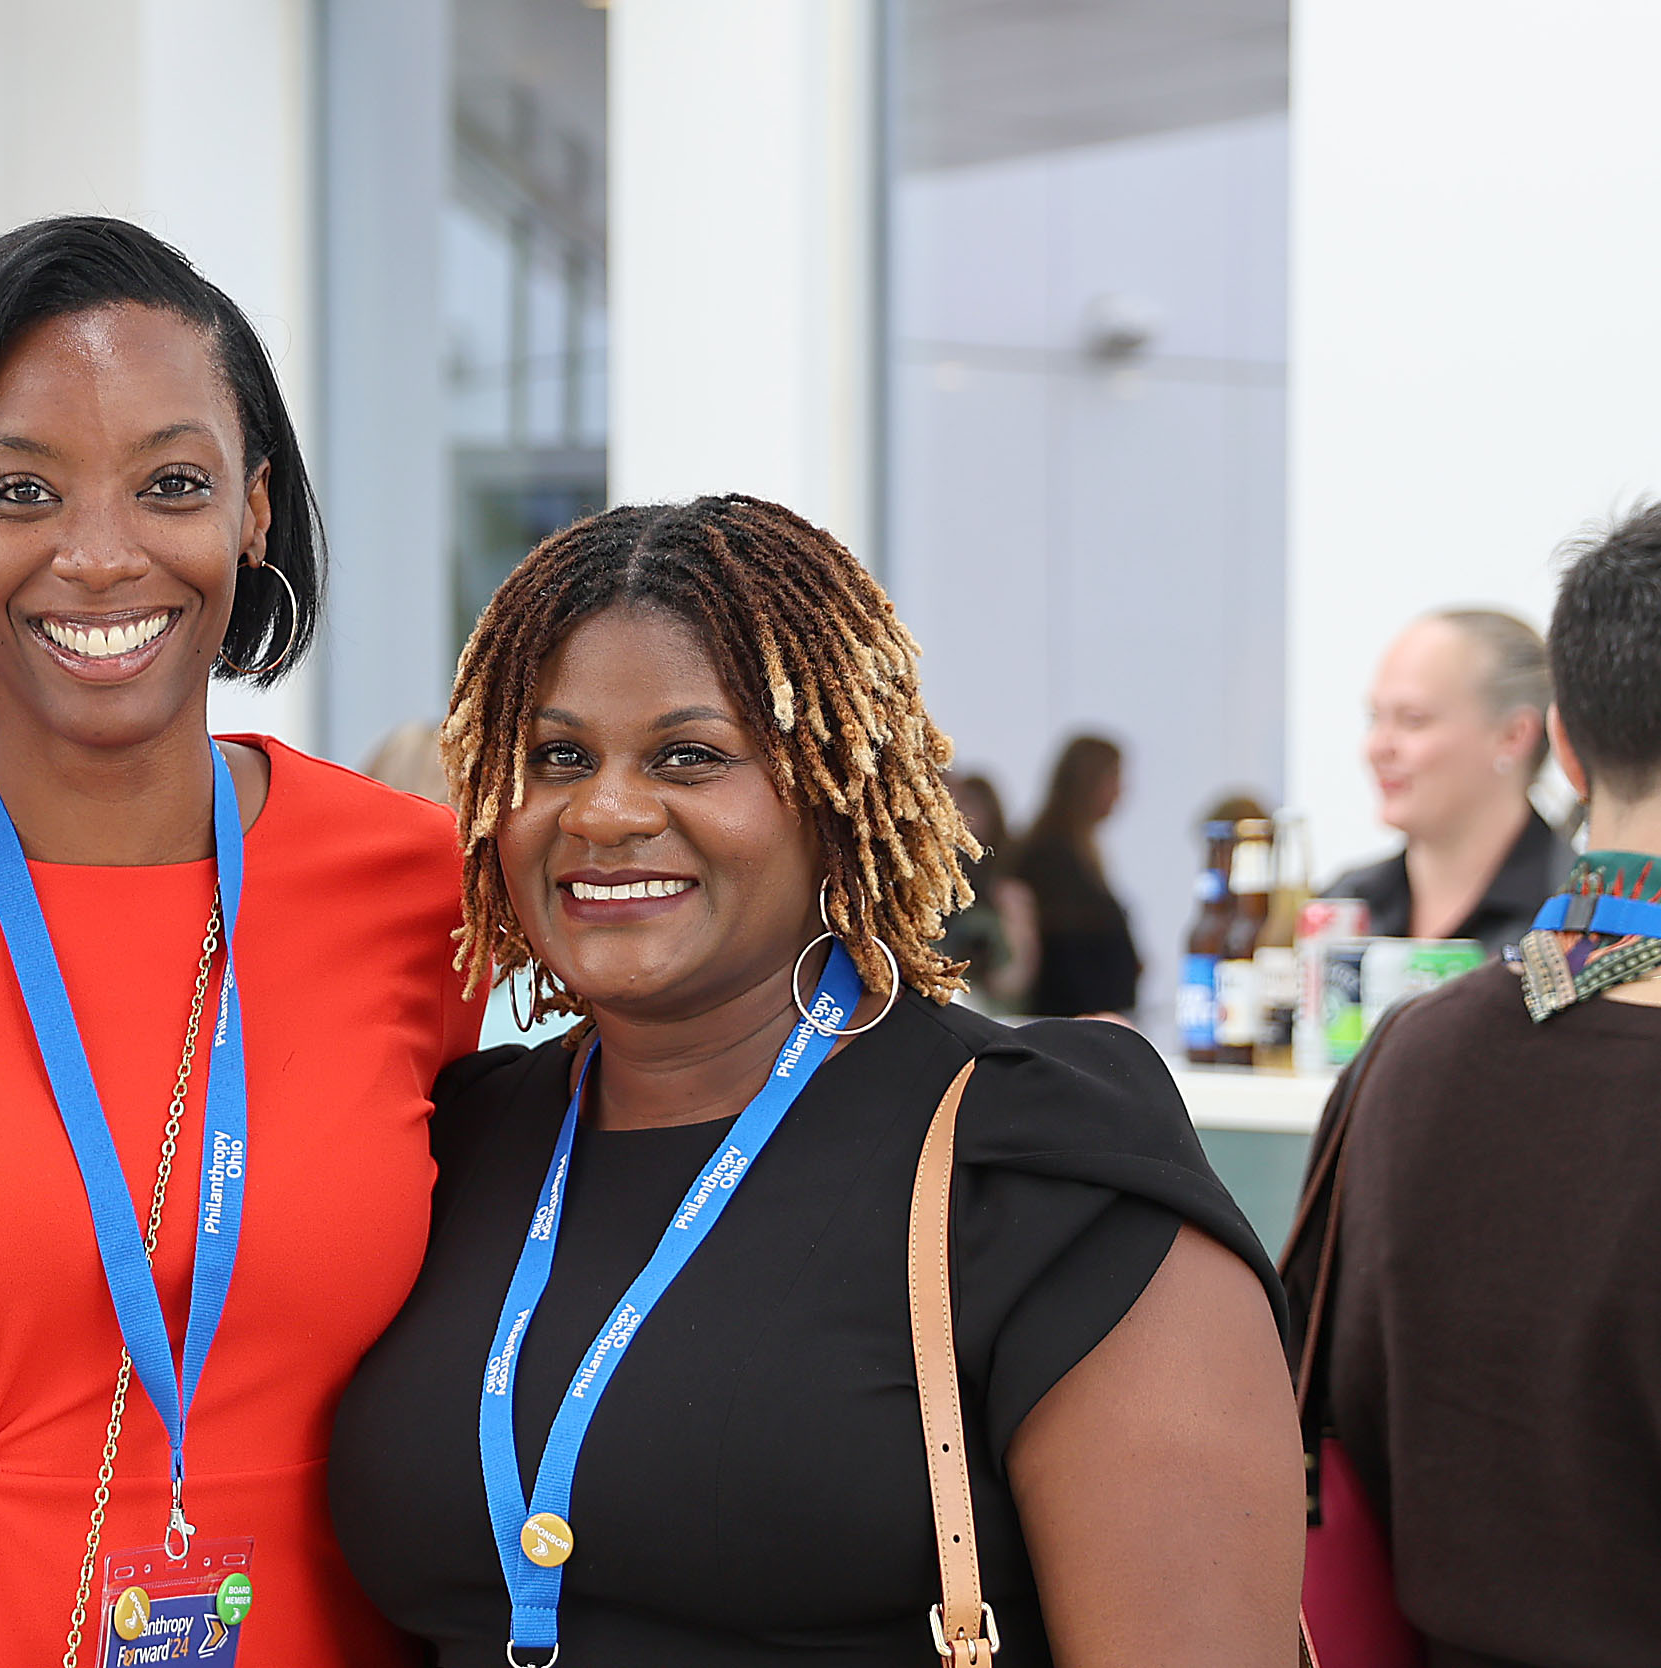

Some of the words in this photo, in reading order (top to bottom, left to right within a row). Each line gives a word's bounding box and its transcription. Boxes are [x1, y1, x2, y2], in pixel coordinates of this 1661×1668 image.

[225, 1139, 244, 1179] Ohio
[719, 1156, 748, 1189] Ohio
[204, 1130, 231, 1234] Philanthropy
[674, 1145, 742, 1230] Philanthropy
[530, 1205, 549, 1239] Ohio
[612, 1314, 642, 1349] Ohio
[494, 1308, 530, 1395] Philanthropy
[571, 1303, 637, 1398] Philanthropy
[485, 1356, 502, 1394] Ohio
[527, 1520, 570, 1551] SPONSOR
[224, 1595, 251, 1605] MEMBER
[227, 1585, 251, 1595] BOARD
[139, 1614, 194, 1638] anthropy
